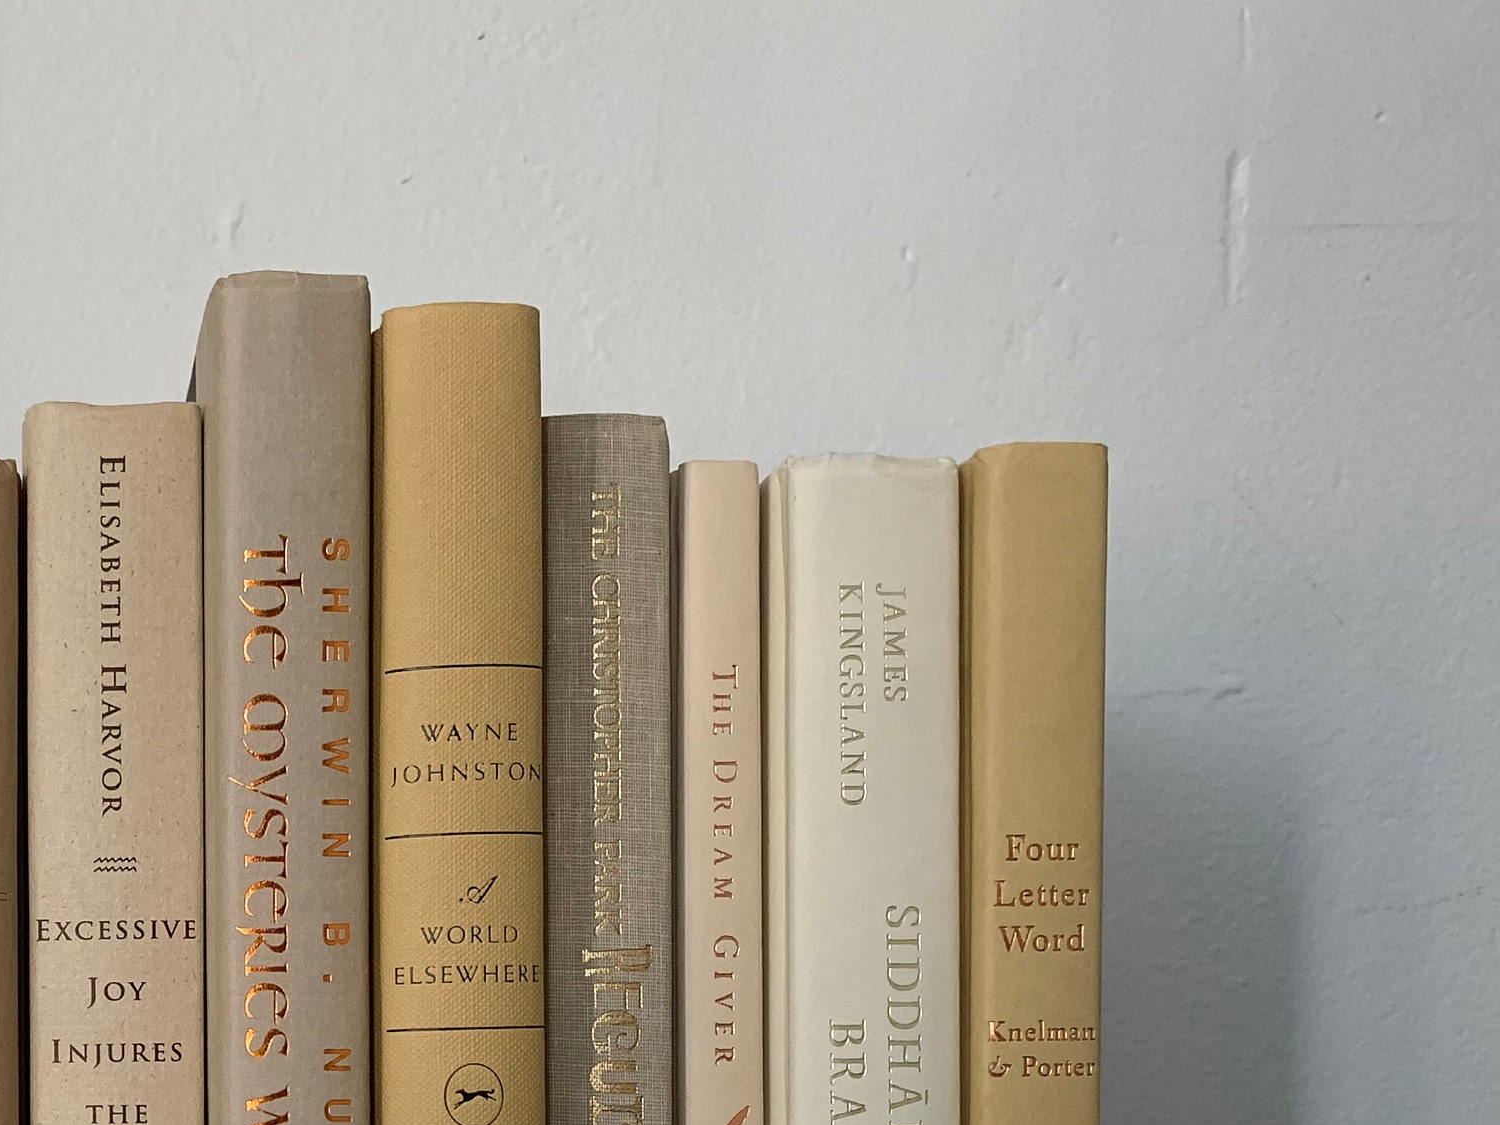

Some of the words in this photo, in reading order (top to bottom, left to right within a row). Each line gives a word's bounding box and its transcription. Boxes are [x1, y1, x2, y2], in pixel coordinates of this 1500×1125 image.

[590, 482, 622, 561] THE
[99, 454, 126, 645] ELISABETH
[875, 582, 909, 703] JAMES
[321, 536, 351, 858] SHERWIN
[592, 572, 623, 828] CHRISTOPHER
[711, 665, 740, 736] THE
[839, 580, 868, 807] KINGSLAND
[101, 663, 128, 817] HARVOR
[420, 721, 519, 745] WAYNE
[391, 761, 543, 787] JOHNSTON
[712, 759, 739, 901] DREAM
[1004, 834, 1079, 865] Four
[593, 839, 622, 938] PARK
[992, 880, 1091, 909] Letter
[35, 919, 197, 942] EXCESSIVE
[420, 924, 519, 945] WORLD
[999, 924, 1087, 954] Word
[322, 923, 351, 983] B.
[394, 964, 541, 987] ELSEWHERE
[87, 976, 146, 1009] JOY
[712, 934, 741, 1067] GIVER
[987, 1020, 1096, 1044] Knelman
[50, 1038, 183, 1068] INJURES
[987, 1056, 1013, 1079] &
[1022, 1055, 1097, 1080] Porter
[85, 1103, 149, 1125] THE
